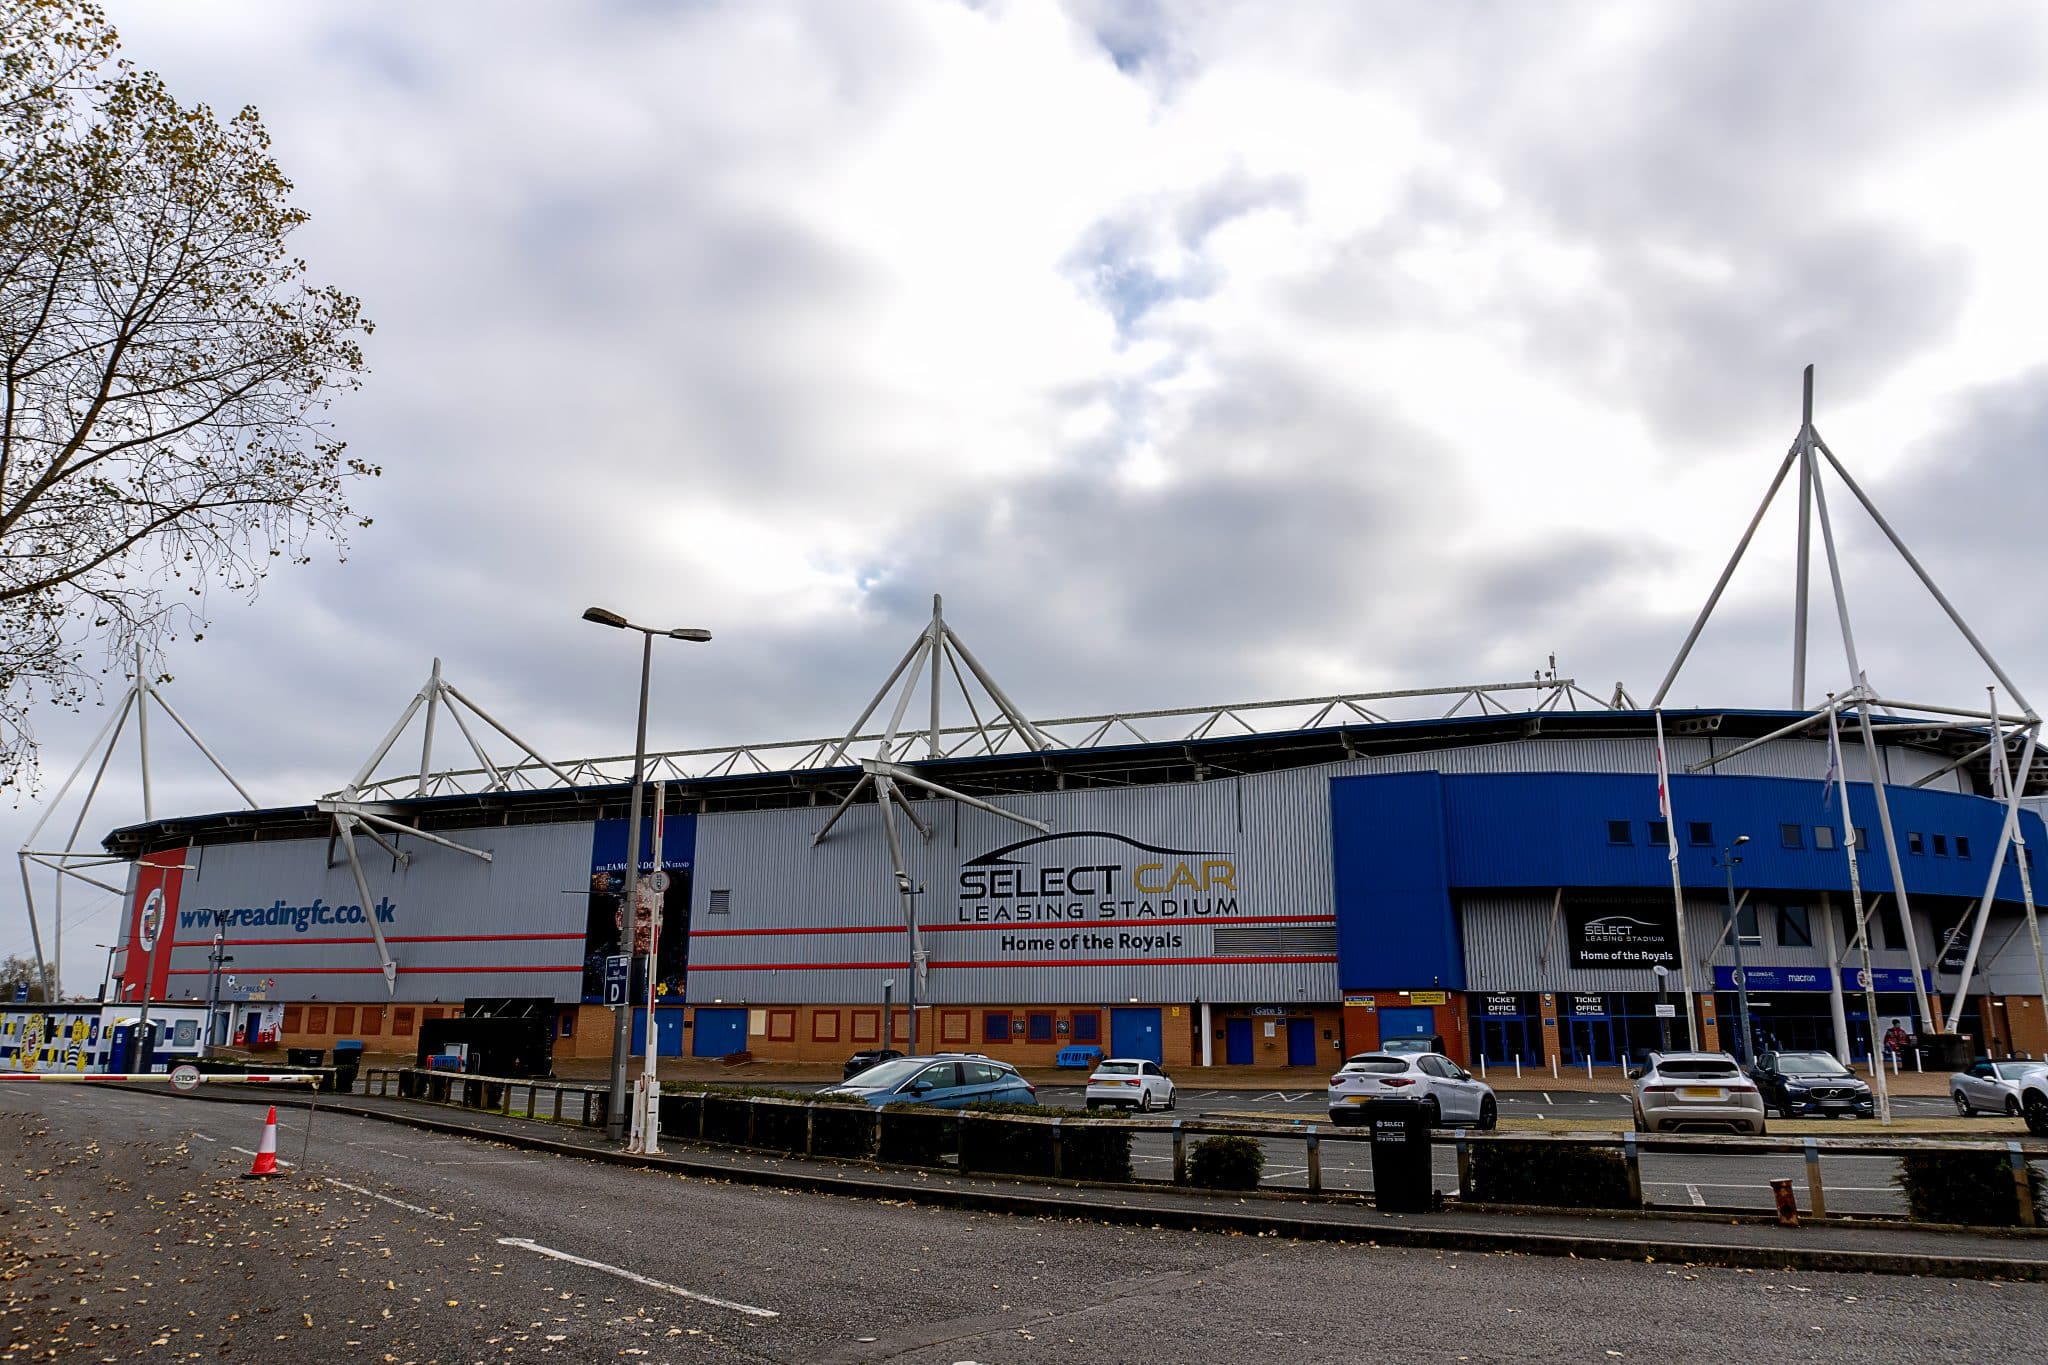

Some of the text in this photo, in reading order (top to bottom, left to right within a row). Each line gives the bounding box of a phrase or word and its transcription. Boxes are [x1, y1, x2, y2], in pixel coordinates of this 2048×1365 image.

[643, 861, 672, 869] DOAN
[959, 860, 1237, 900] SELECT CAR
[959, 898, 1239, 922] LEASING STADIUM
[1584, 925, 1632, 935] SELECT
[1001, 932, 1182, 951] Home of the Royals
[1580, 950, 1673, 962] Home of the Royals
[1788, 973, 1816, 982] macron
[611, 984, 620, 1001] D
[1255, 1006, 1275, 1015] Gate
[175, 1074, 196, 1082] STOP
